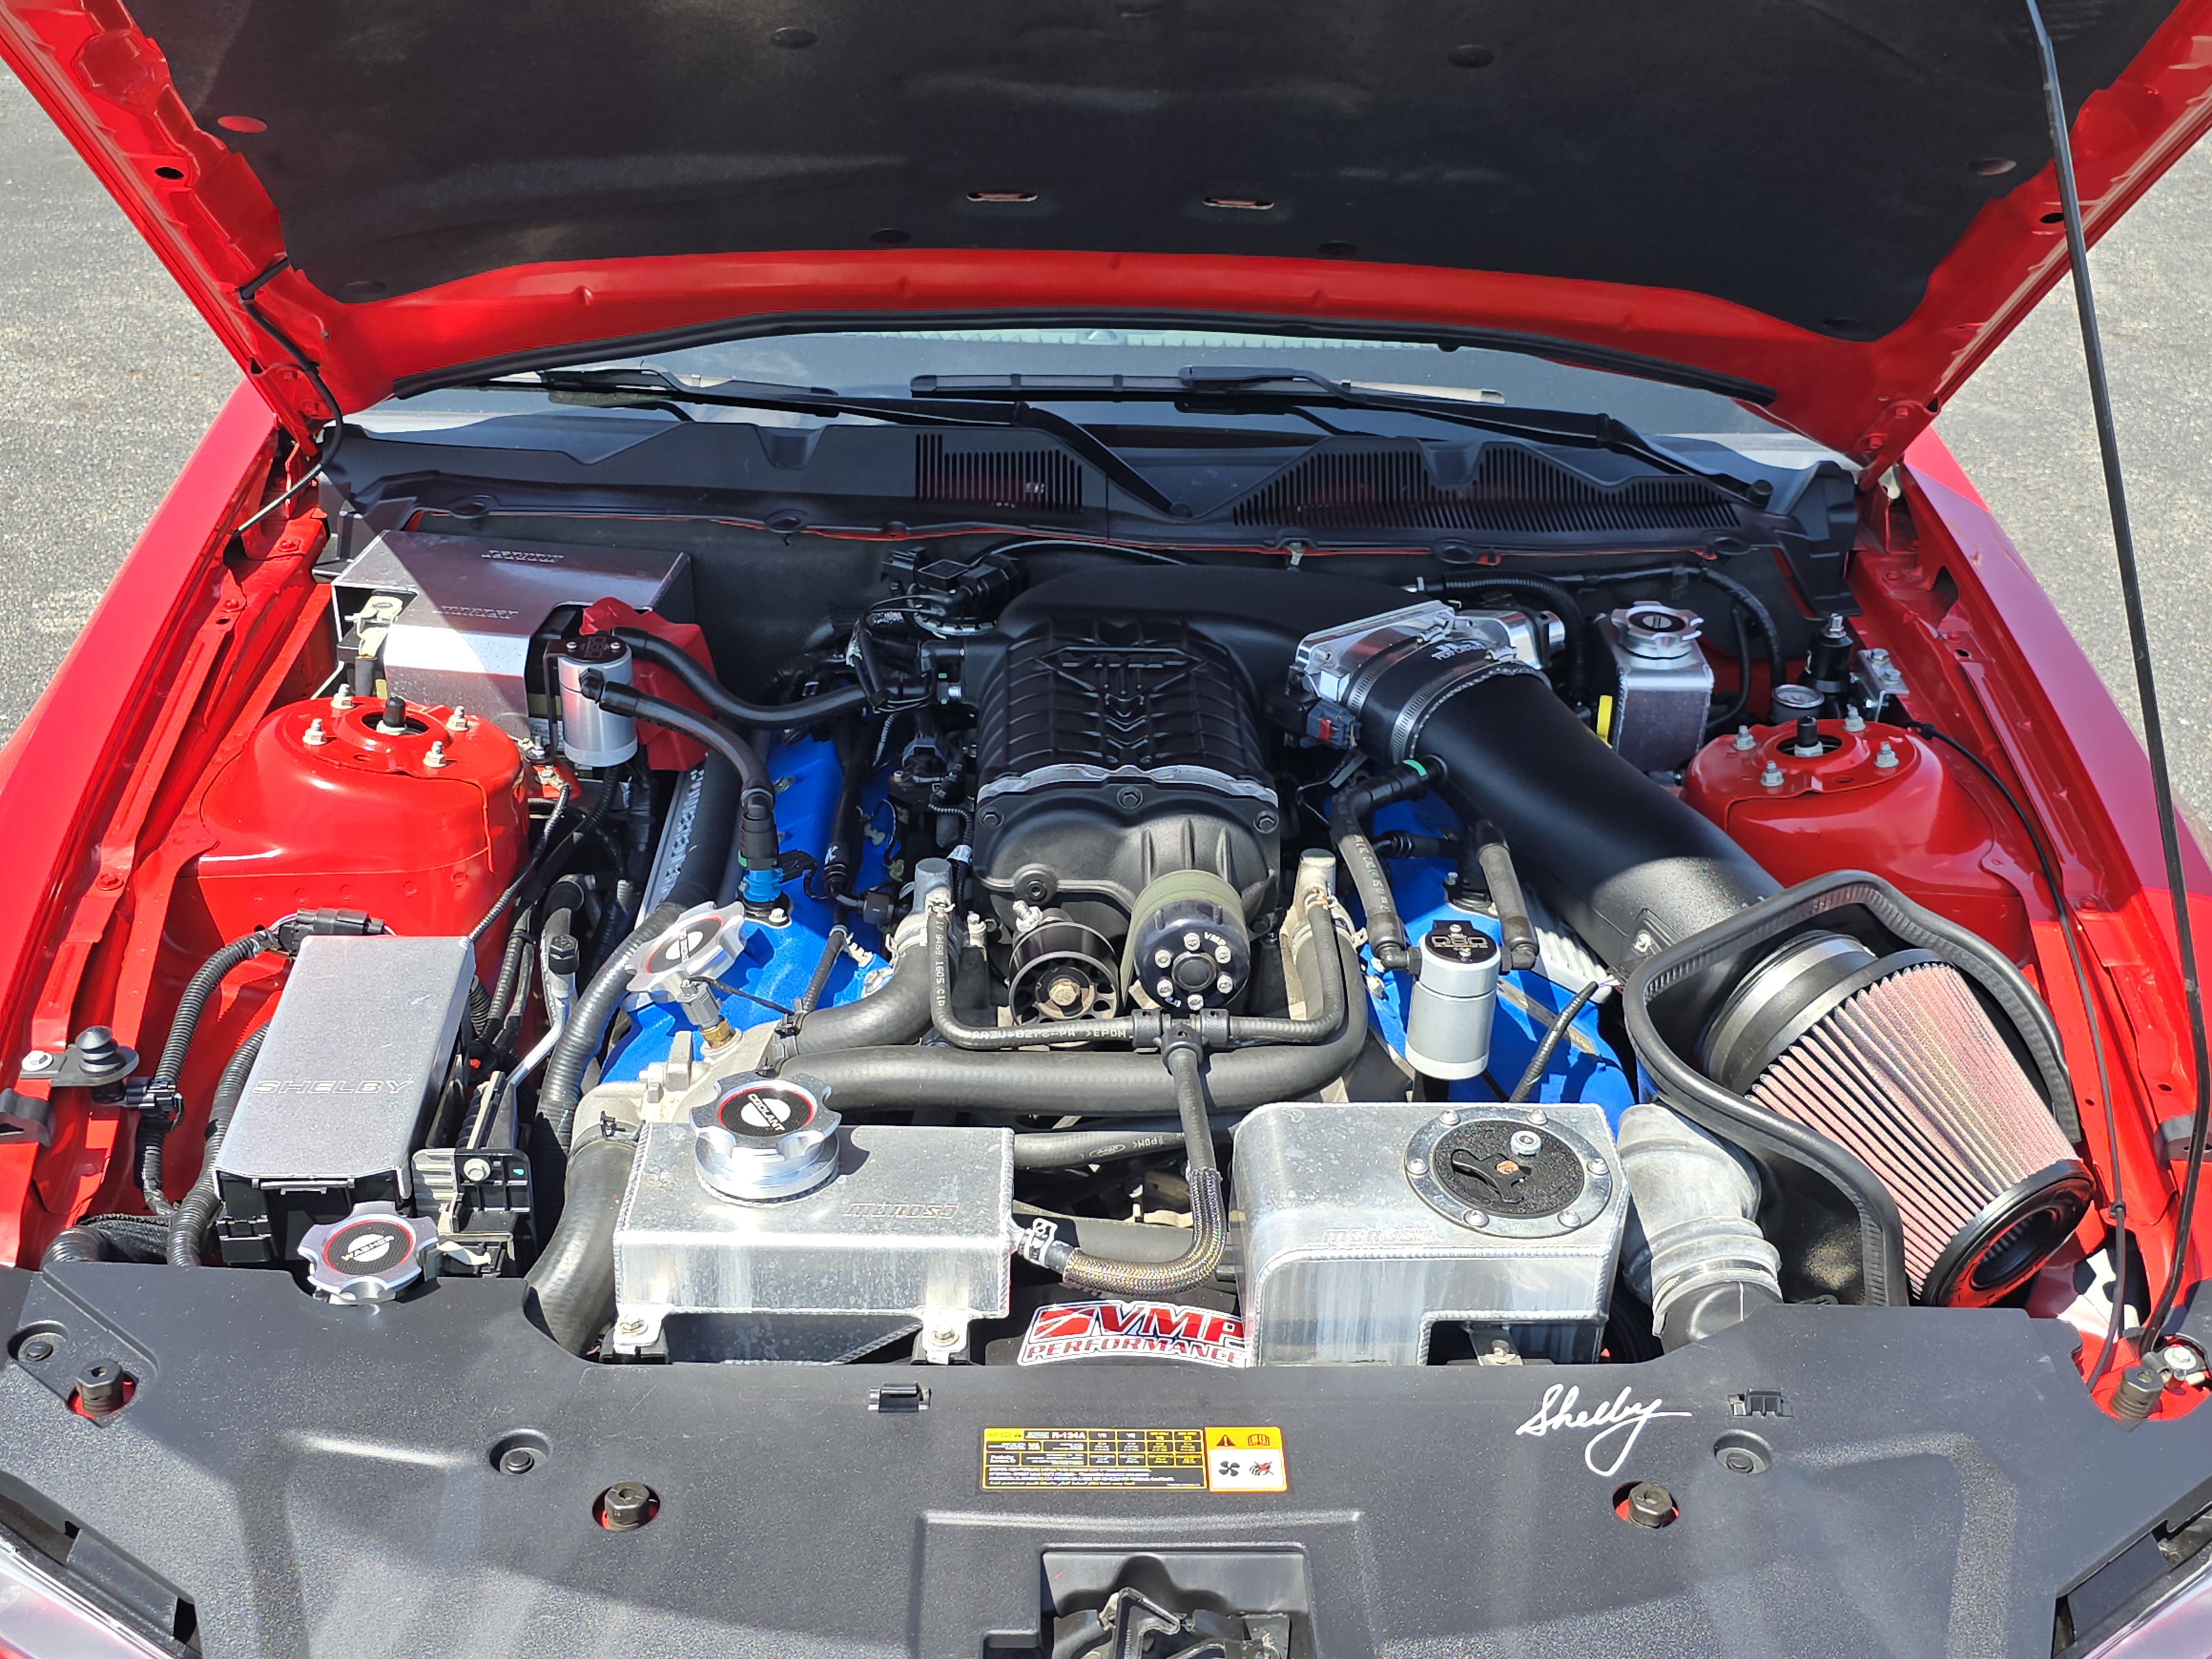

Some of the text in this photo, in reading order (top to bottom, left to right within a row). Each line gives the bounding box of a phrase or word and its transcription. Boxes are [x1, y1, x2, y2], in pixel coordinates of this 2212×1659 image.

[1204, 931, 1227, 946] VMP
[252, 1080, 414, 1094] SHELBY
[747, 1093, 785, 1130] COOLANT
[843, 1203, 959, 1219] MOROSO
[1099, 1305, 1245, 1343] VMP
[1026, 1337, 1245, 1364] PERFORMANCE
[1515, 1383, 1692, 1477] Shelby
